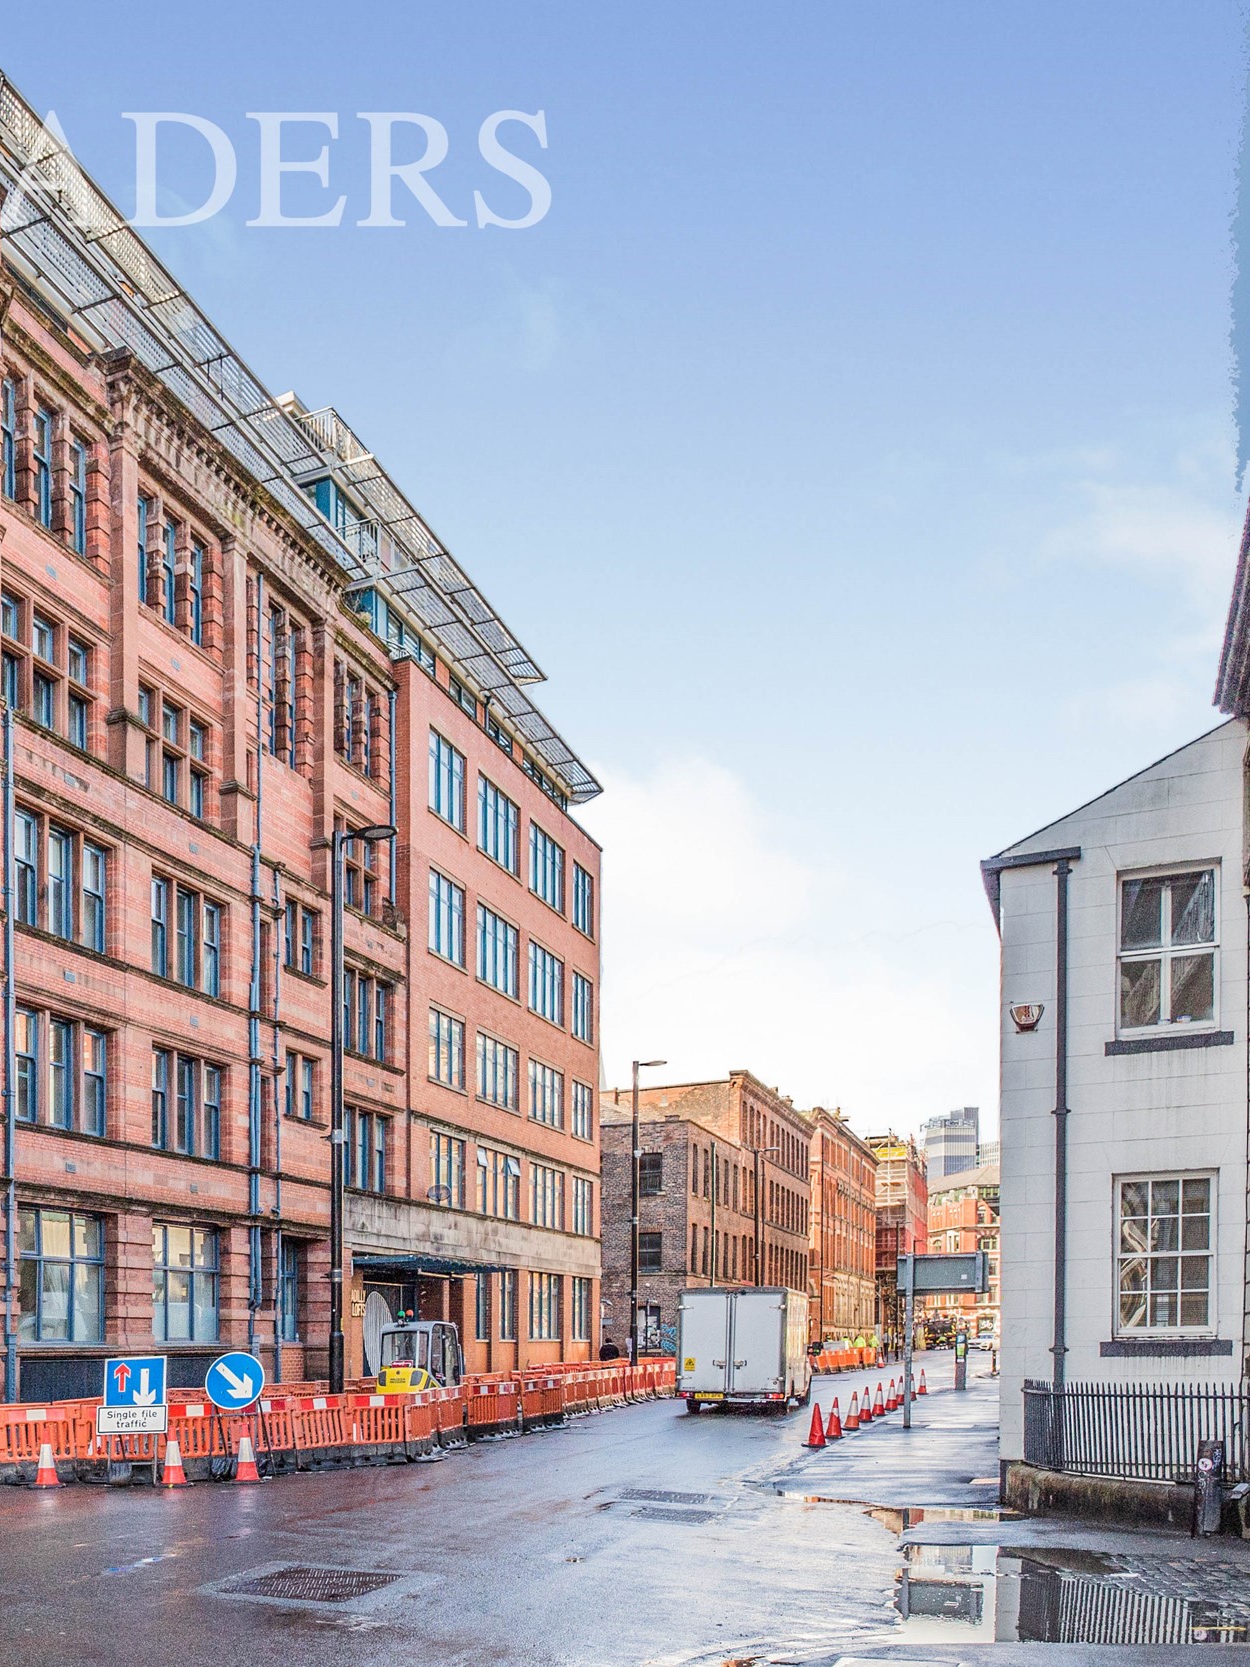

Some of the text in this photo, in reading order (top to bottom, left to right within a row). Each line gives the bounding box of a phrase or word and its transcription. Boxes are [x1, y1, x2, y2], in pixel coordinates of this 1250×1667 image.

[352, 1304, 367, 1317] LOFTS
[107, 1410, 158, 1420] Single file
[116, 1420, 147, 1428] traffic
